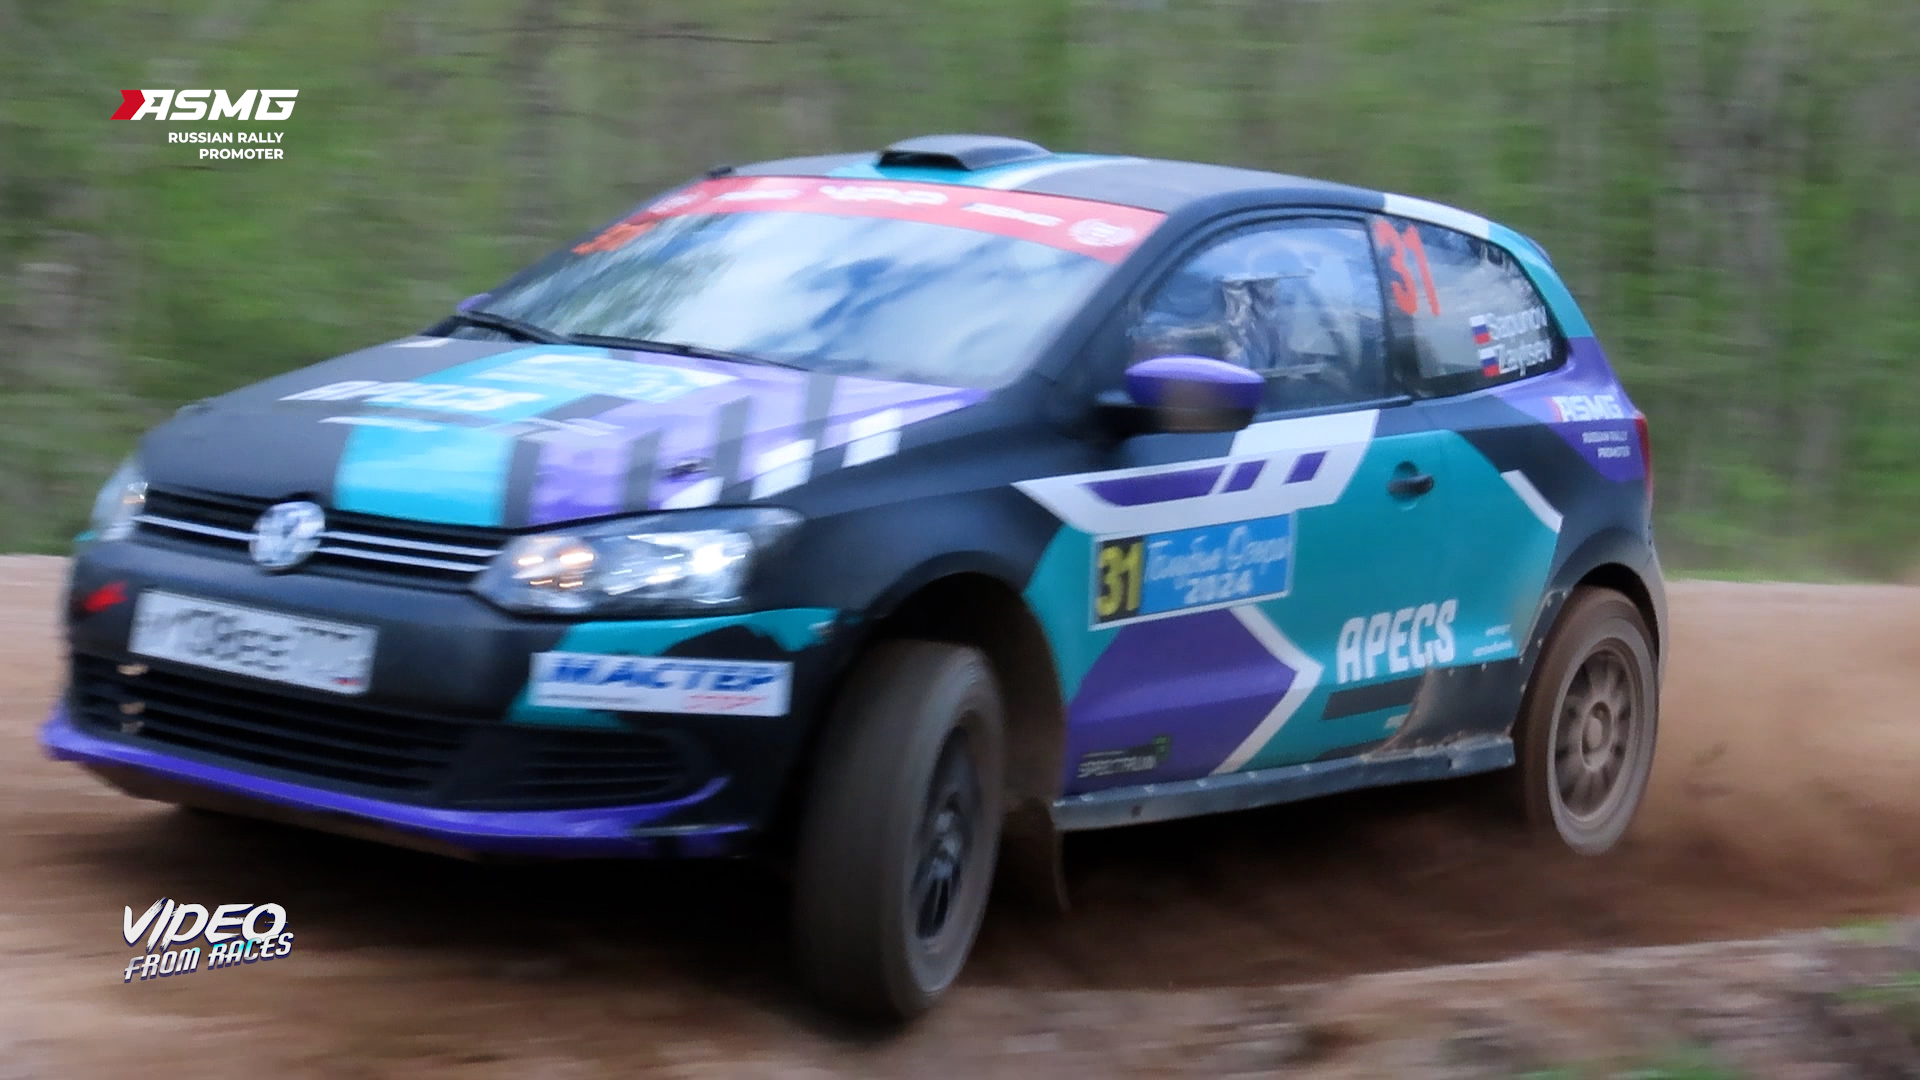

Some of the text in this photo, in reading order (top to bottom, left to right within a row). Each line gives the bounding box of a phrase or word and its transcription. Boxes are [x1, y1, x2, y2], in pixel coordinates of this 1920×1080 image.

[1373, 219, 1441, 316] 31
[1095, 540, 1144, 617] 31
[1183, 570, 1252, 605] 2024
[1335, 599, 1457, 684] APECS
